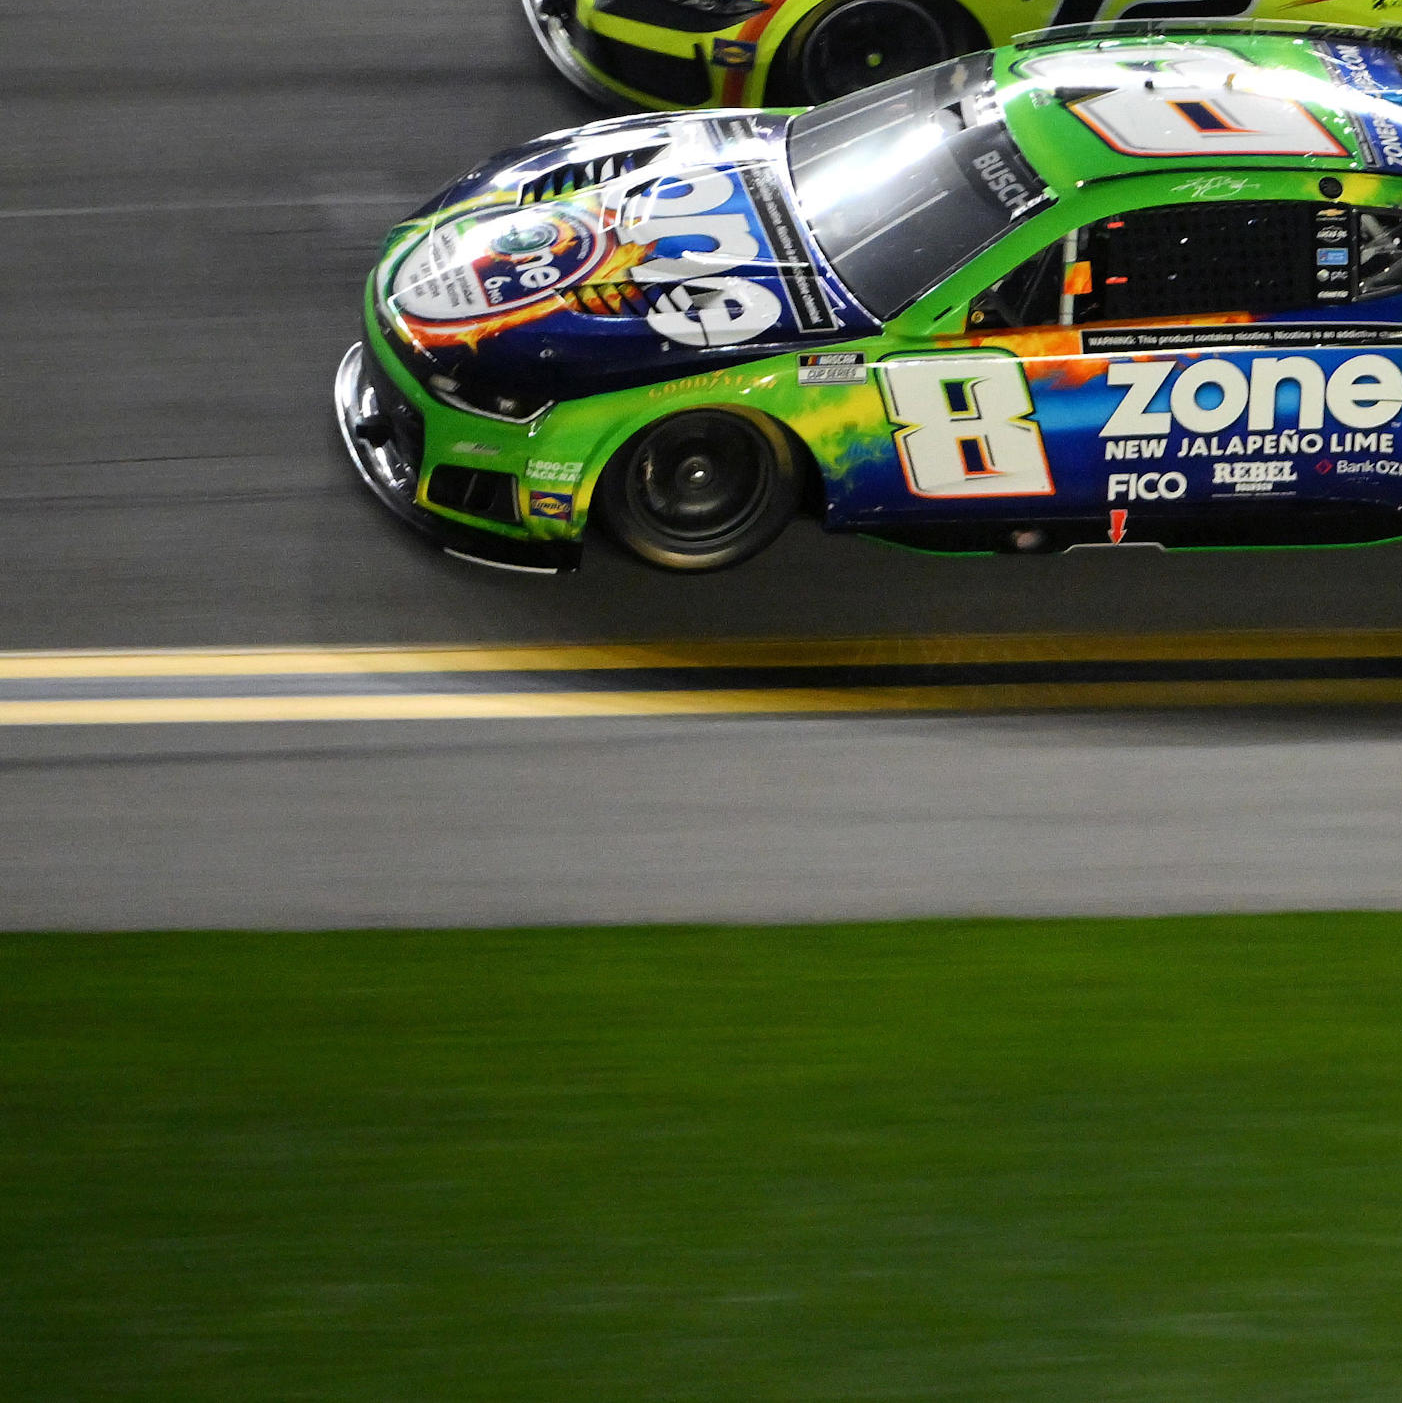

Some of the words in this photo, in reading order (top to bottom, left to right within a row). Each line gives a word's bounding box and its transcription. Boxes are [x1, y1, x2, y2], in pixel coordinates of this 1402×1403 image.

[974, 150, 1031, 212] BUSCH
[879, 348, 1056, 498] 8
[1105, 438, 1165, 460] NEW
[1177, 429, 1323, 458] JALAPEÑO
[1329, 433, 1394, 455] LIME
[1212, 461, 1298, 484] REBEL
[1337, 460, 1375, 474] Bank
[1108, 472, 1187, 502] FICO
